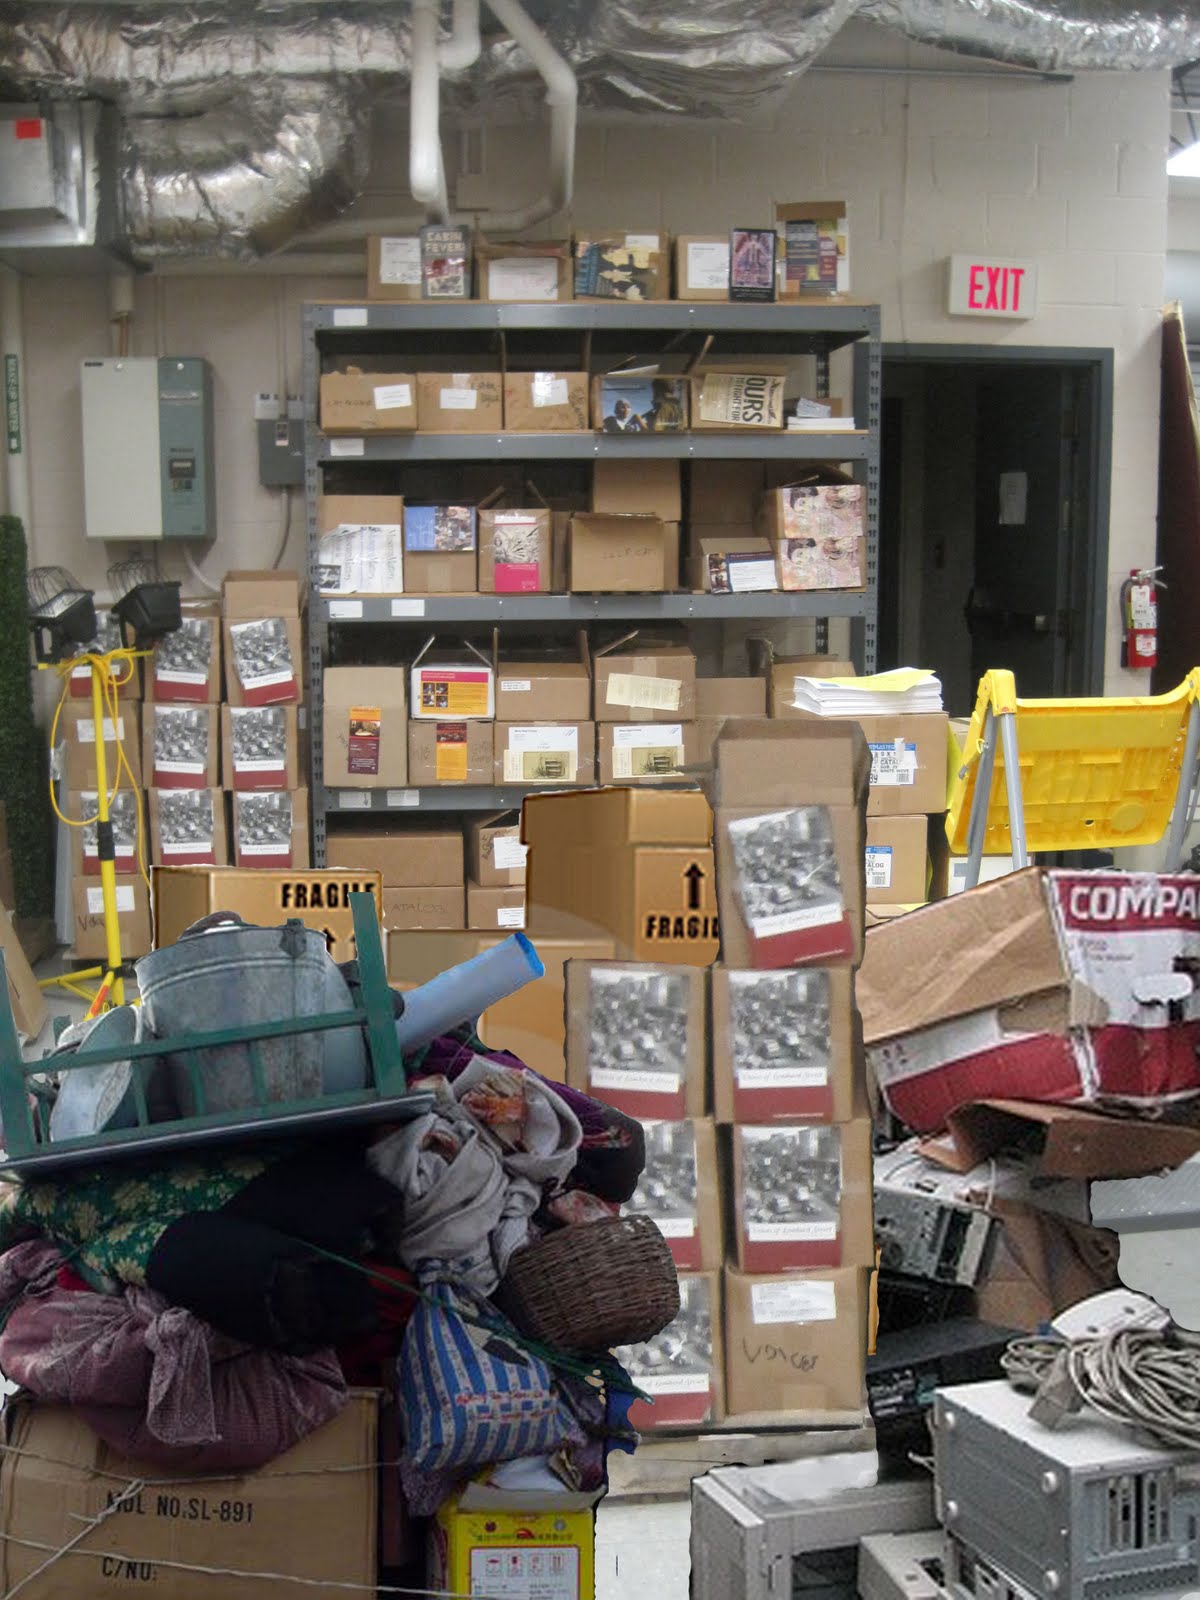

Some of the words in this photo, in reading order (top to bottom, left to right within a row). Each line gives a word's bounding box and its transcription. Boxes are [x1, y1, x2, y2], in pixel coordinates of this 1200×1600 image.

[968, 265, 1025, 312] EXIT
[733, 384, 744, 405] FIGHT
[742, 377, 767, 423] OURS
[731, 406, 741, 421] FOR
[1070, 885, 1200, 921] COMPA
[645, 916, 719, 939] FRAGIL
